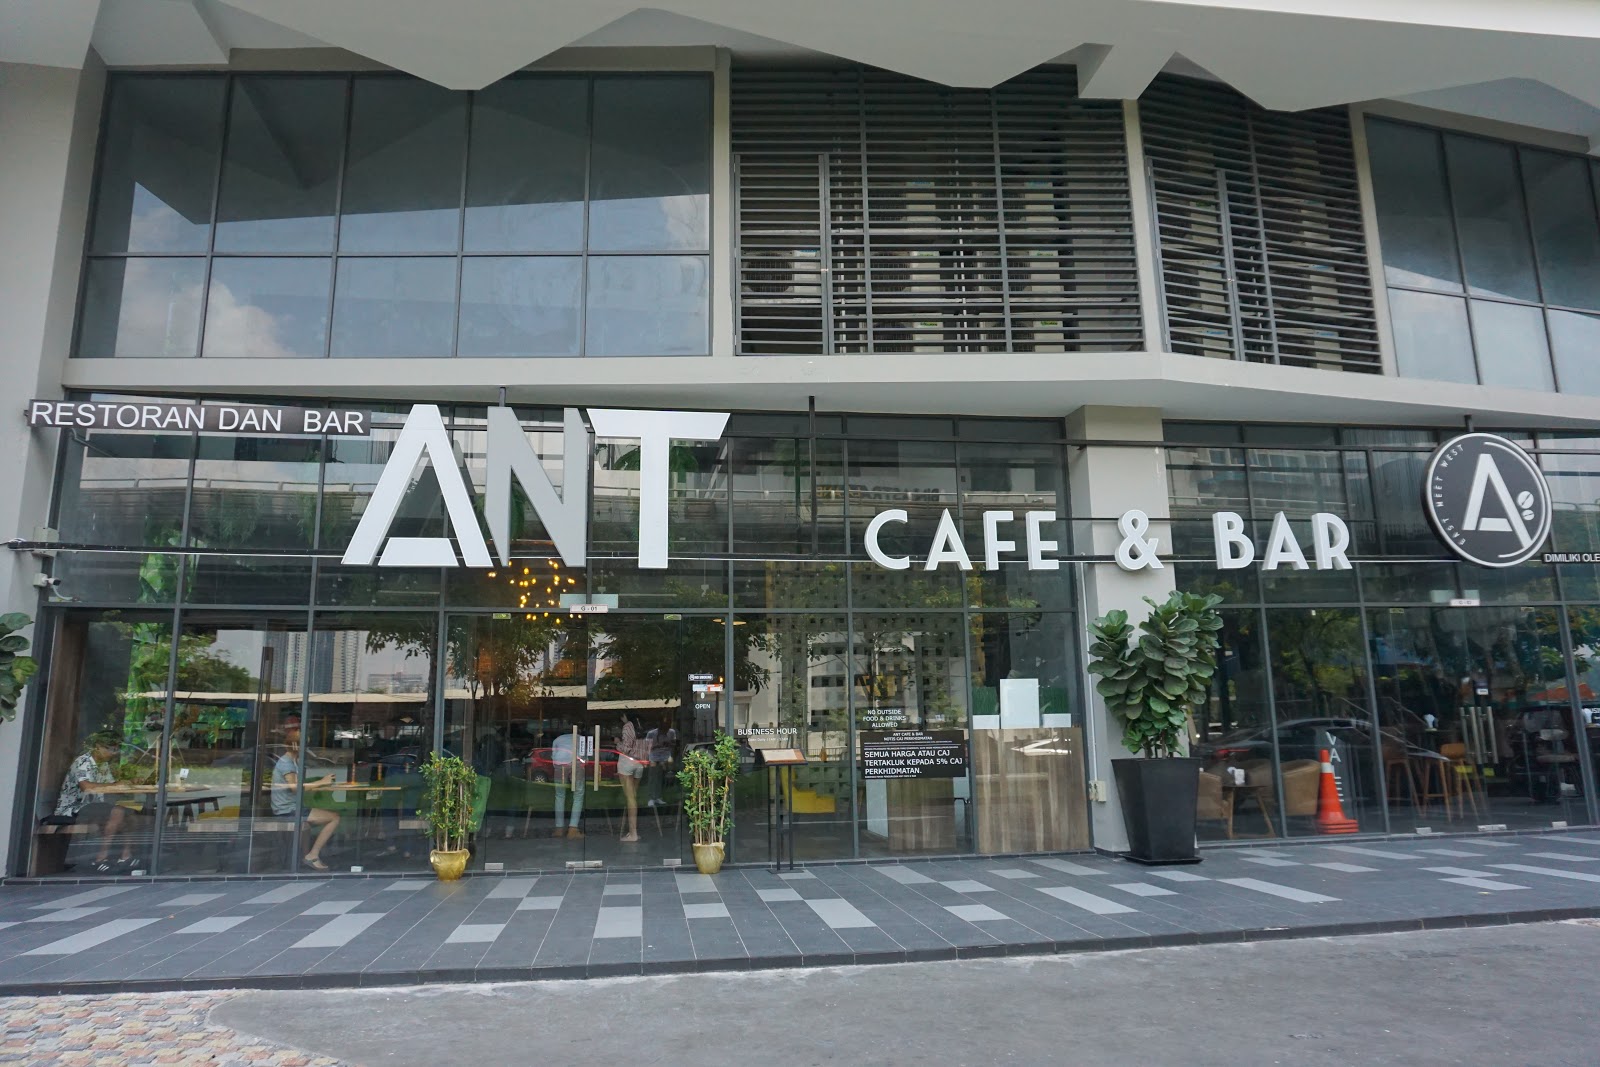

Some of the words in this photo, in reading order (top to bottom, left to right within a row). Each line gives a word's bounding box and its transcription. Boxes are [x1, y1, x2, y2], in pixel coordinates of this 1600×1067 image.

[30, 402, 205, 430] RESTORAN
[218, 409, 282, 431] DAN
[303, 411, 364, 433] BAR
[1440, 444, 1464, 468] WEST
[341, 404, 730, 569] ANT
[1434, 476, 1444, 507] MEET
[864, 508, 1060, 571] CAFE
[1115, 509, 1164, 572] &
[1212, 510, 1353, 571] BAR
[1441, 518, 1466, 545] EAST
[1544, 553, 1580, 562] DIMILIKI
[737, 728, 774, 736] BUSINESS
[777, 727, 797, 735] HOUR
[864, 767, 922, 775] PERKHIDMATAN.
